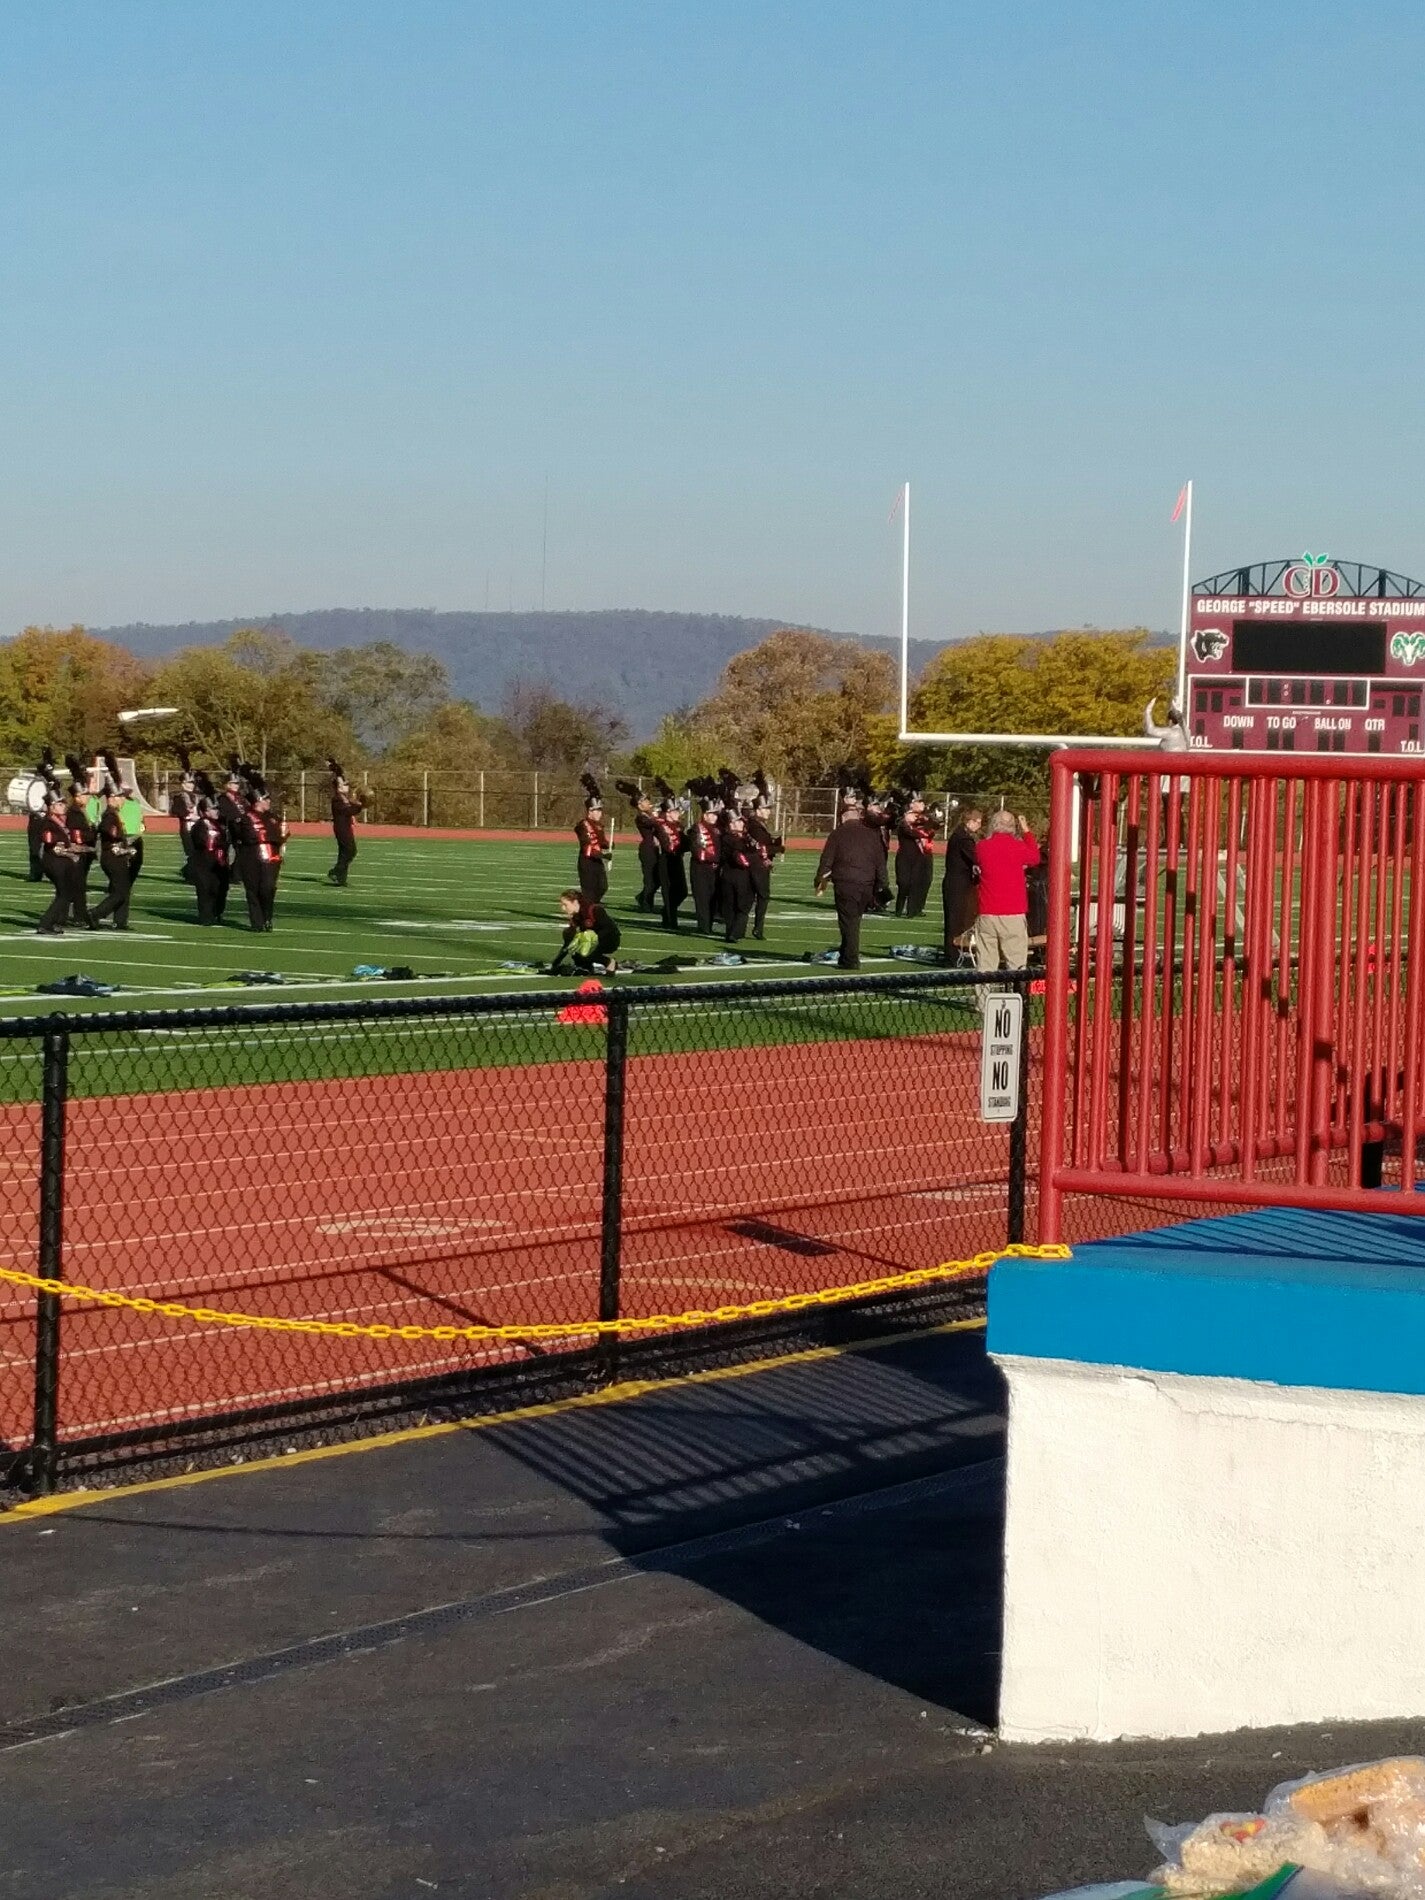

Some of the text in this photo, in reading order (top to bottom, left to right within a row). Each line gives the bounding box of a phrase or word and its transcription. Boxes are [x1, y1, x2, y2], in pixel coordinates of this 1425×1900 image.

[1283, 566, 1340, 598] CD
[1197, 599, 1425, 616] GEORGE "SPEED" EBERSOLE STADIUM
[1224, 716, 1254, 728] DOWN
[1267, 717, 1296, 729] TO GO
[1314, 718, 1351, 730] BALL ON
[1365, 719, 1385, 730] QTR
[994, 1009, 1011, 1038] NO
[992, 1061, 1009, 1090] NO
